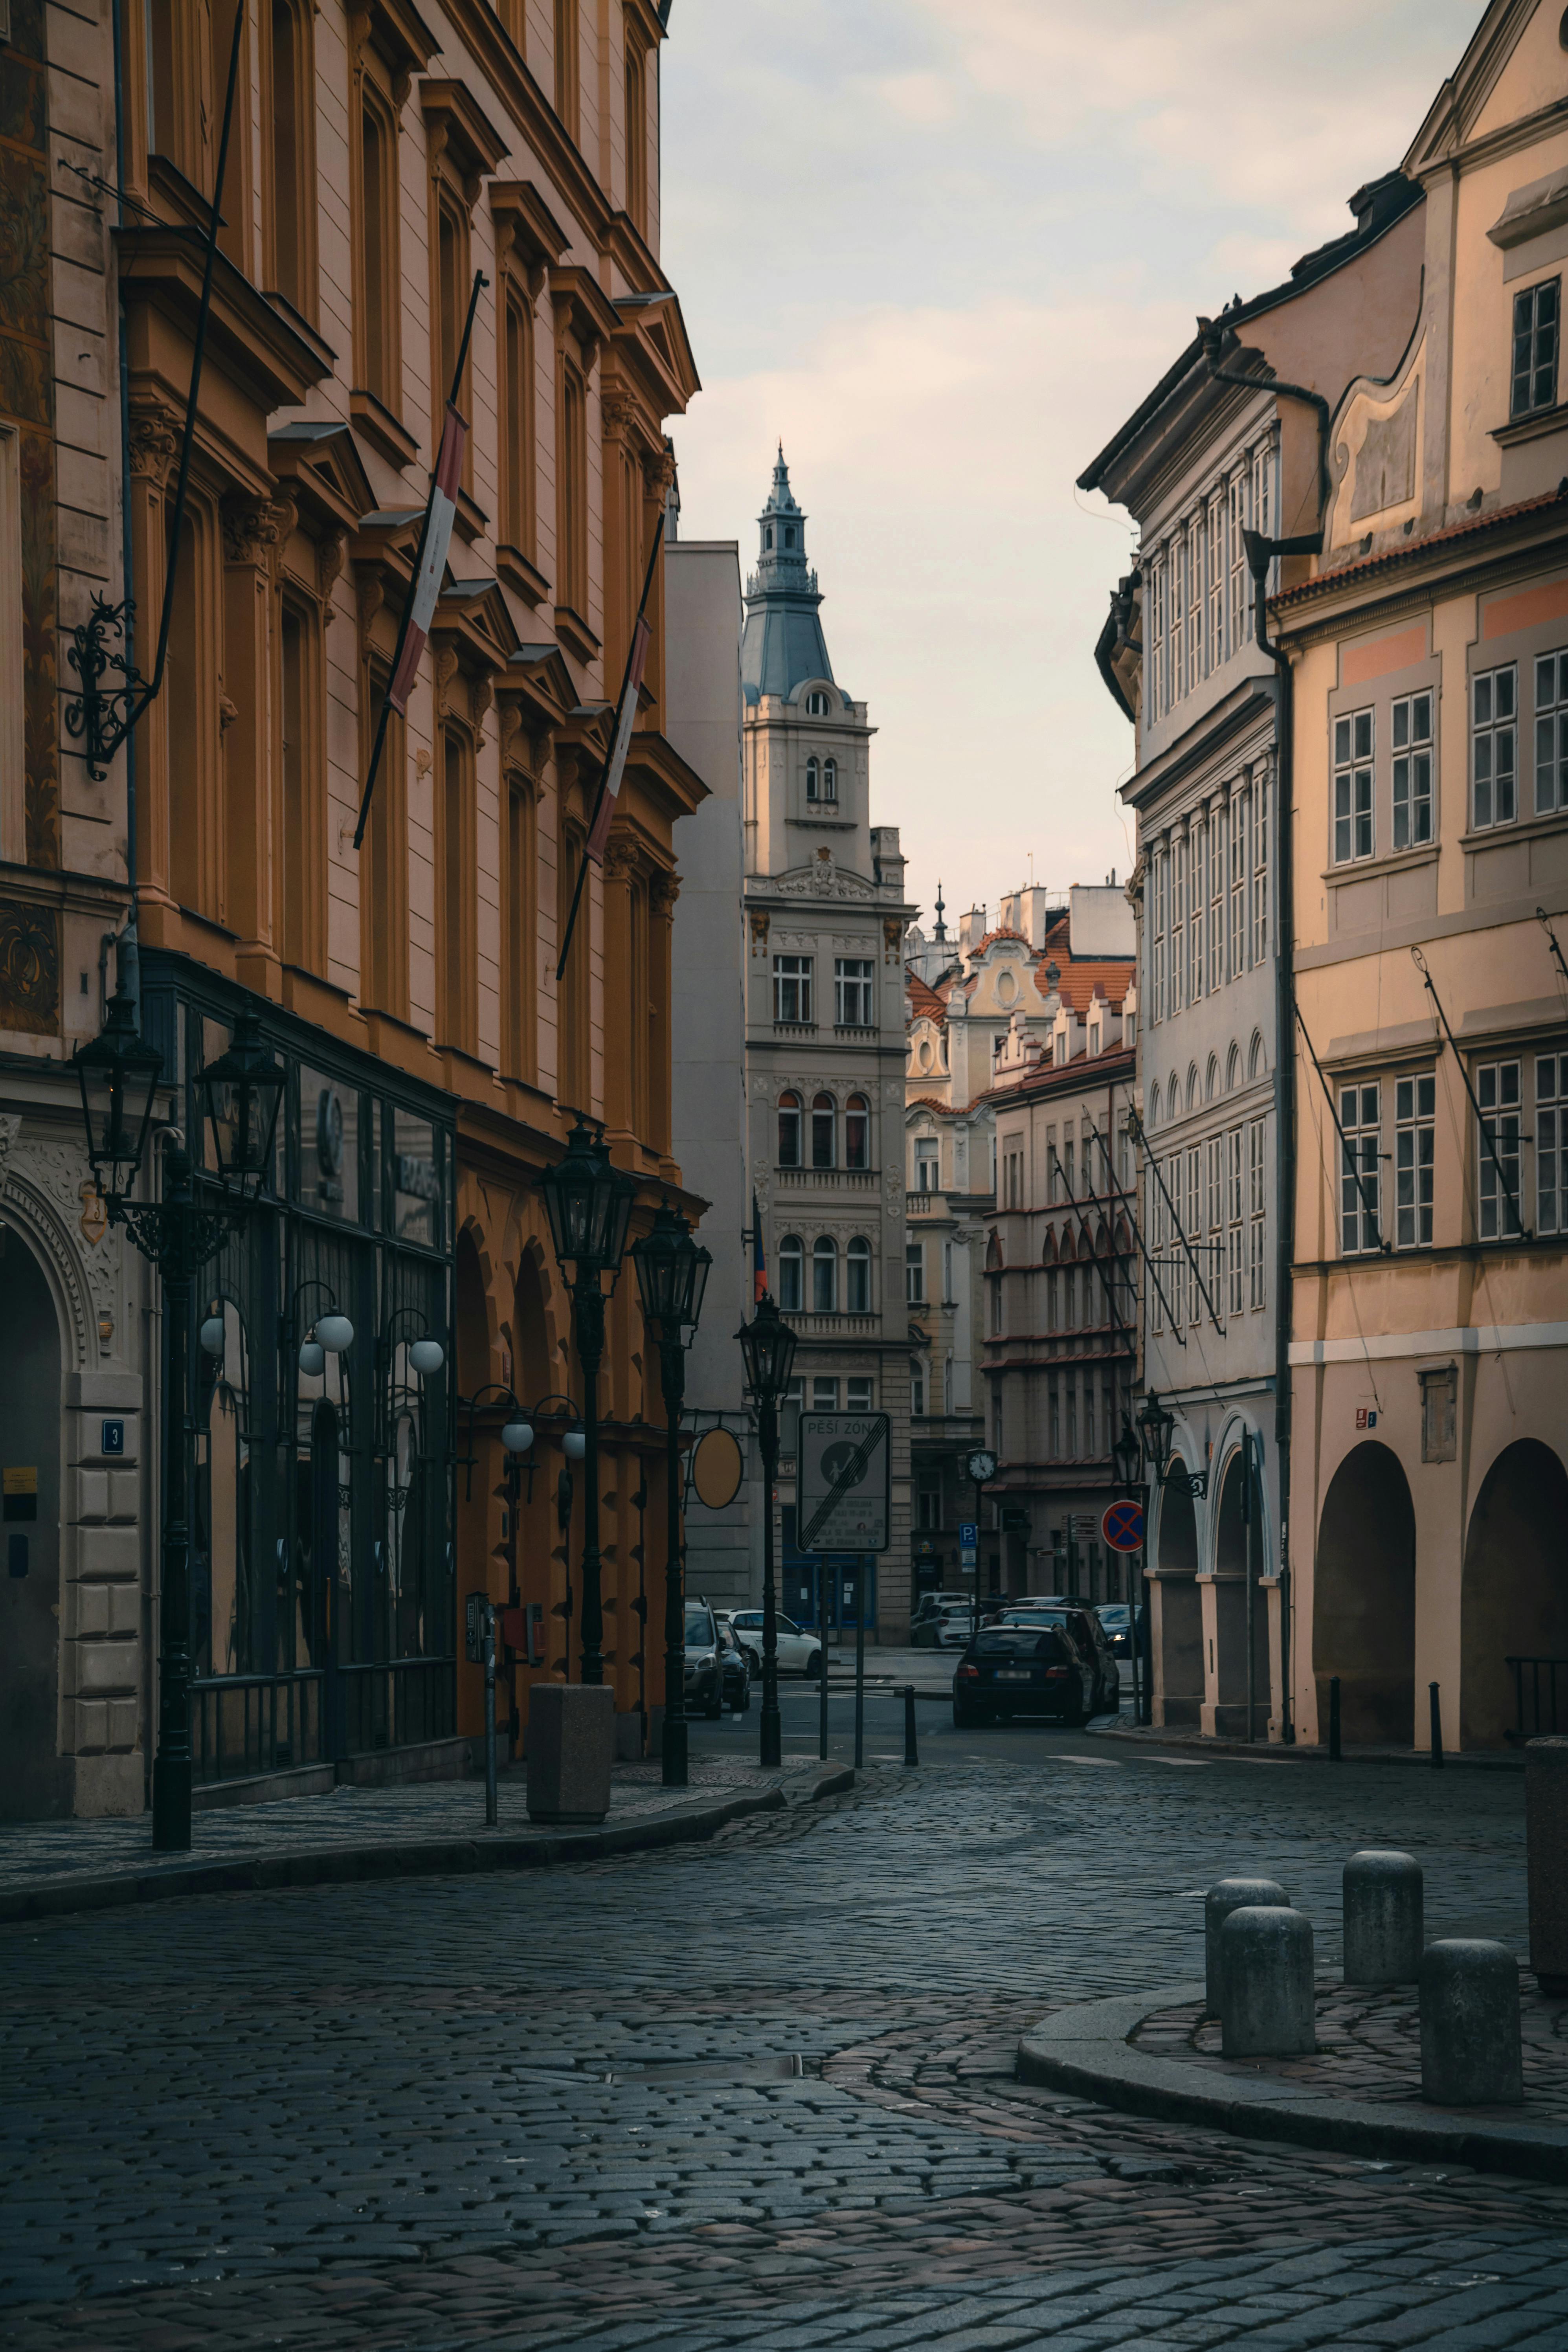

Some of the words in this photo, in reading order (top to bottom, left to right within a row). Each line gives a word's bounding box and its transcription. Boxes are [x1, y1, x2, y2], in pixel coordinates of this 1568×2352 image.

[1370, 1415, 1373, 1424] 2
[808, 1420, 839, 1434] PĚŠÍ
[112, 1428, 118, 1445] 3
